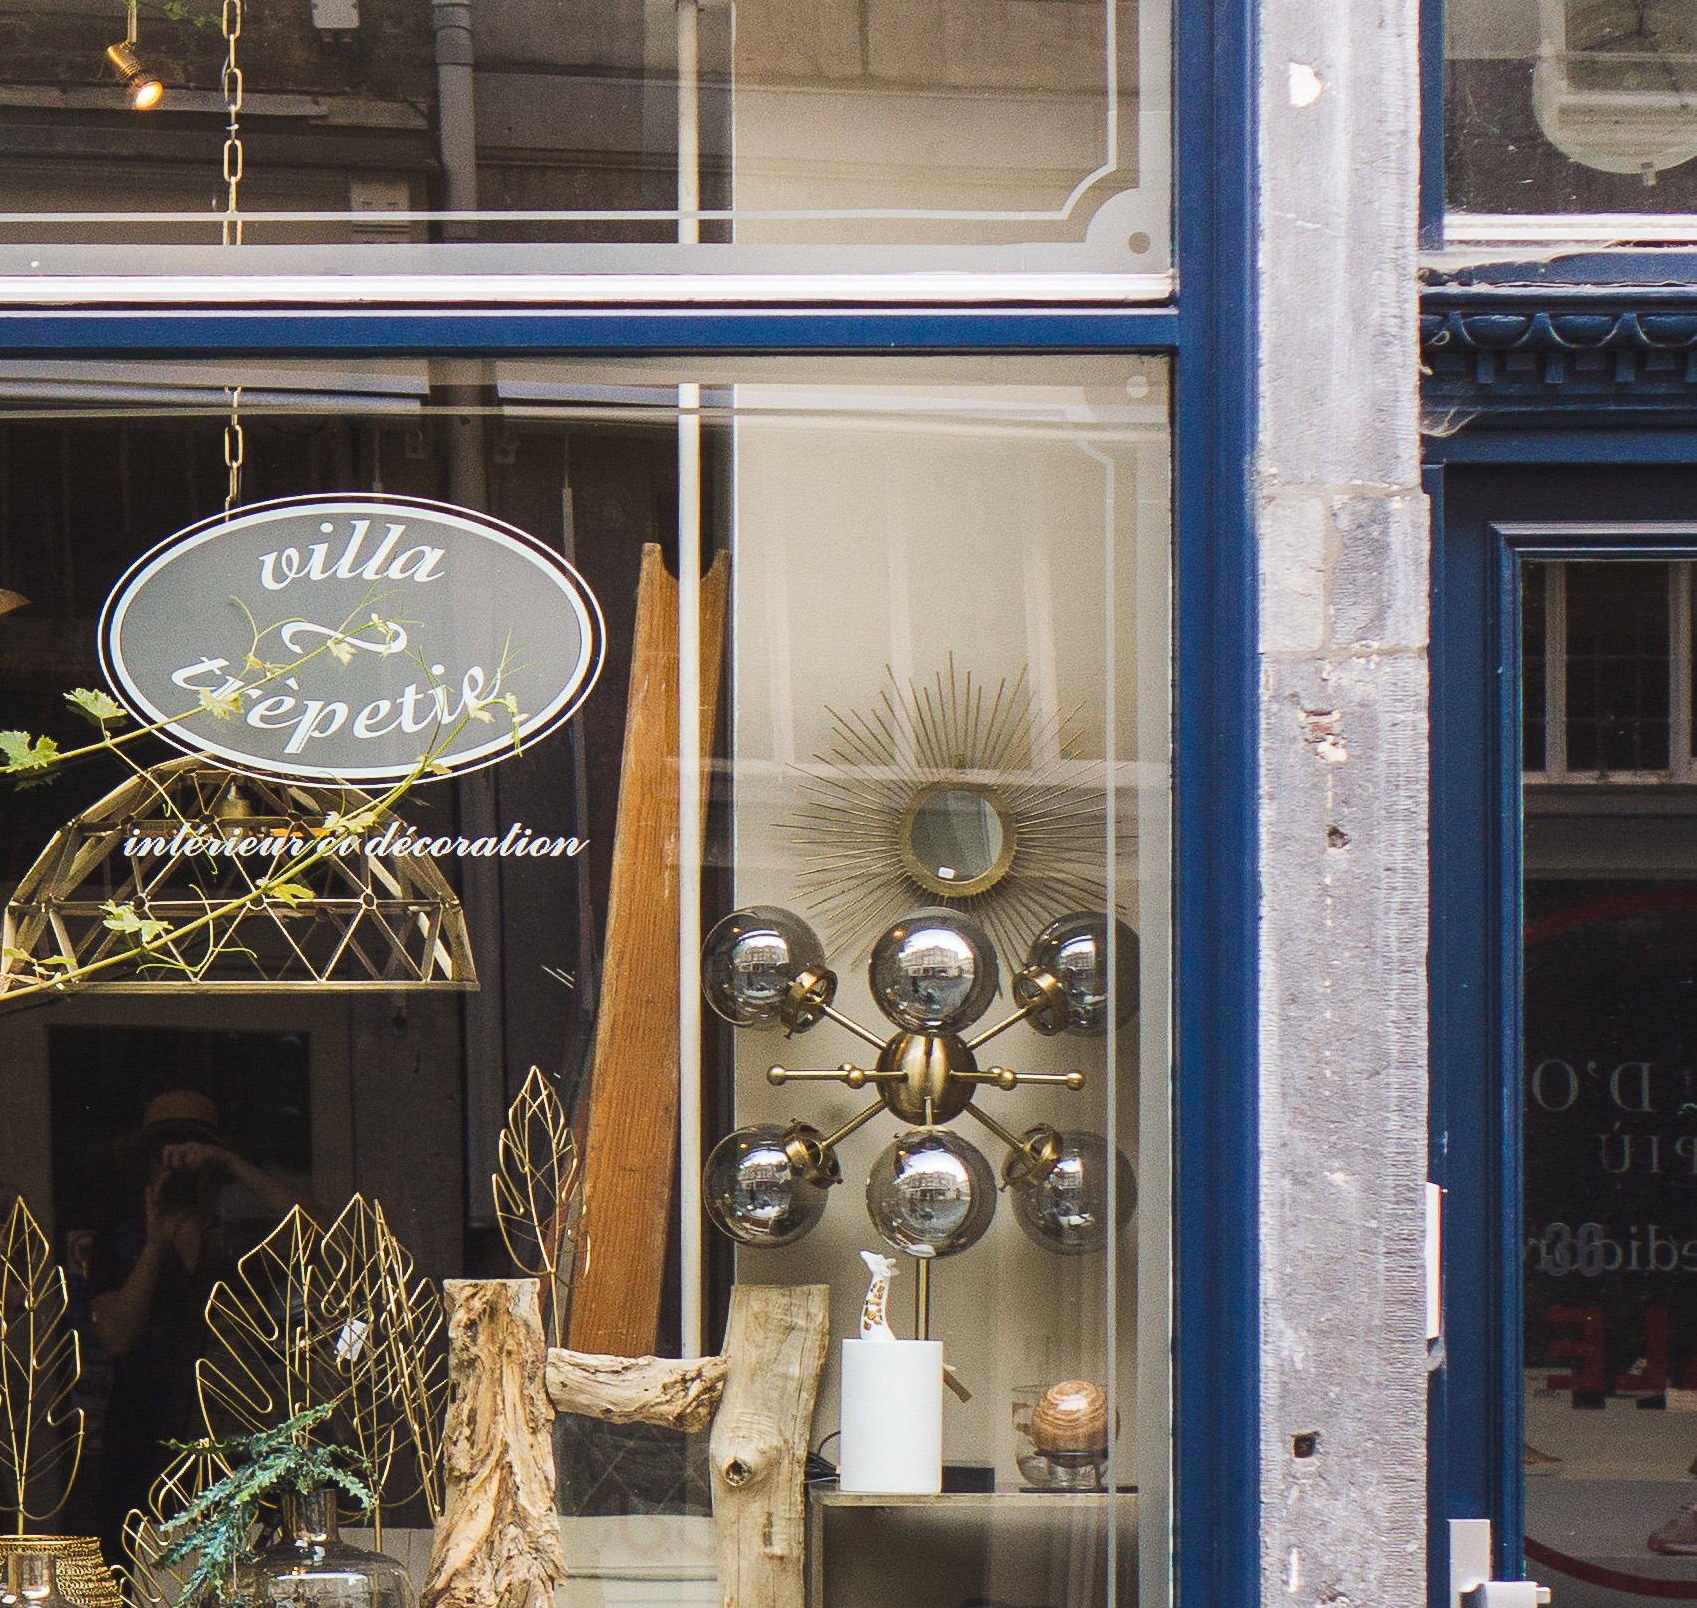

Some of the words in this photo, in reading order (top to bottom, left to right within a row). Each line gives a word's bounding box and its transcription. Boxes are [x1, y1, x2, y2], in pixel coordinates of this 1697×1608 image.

[259, 519, 445, 591] villa
[123, 822, 313, 857] intérieur
[365, 821, 590, 858] décoration
